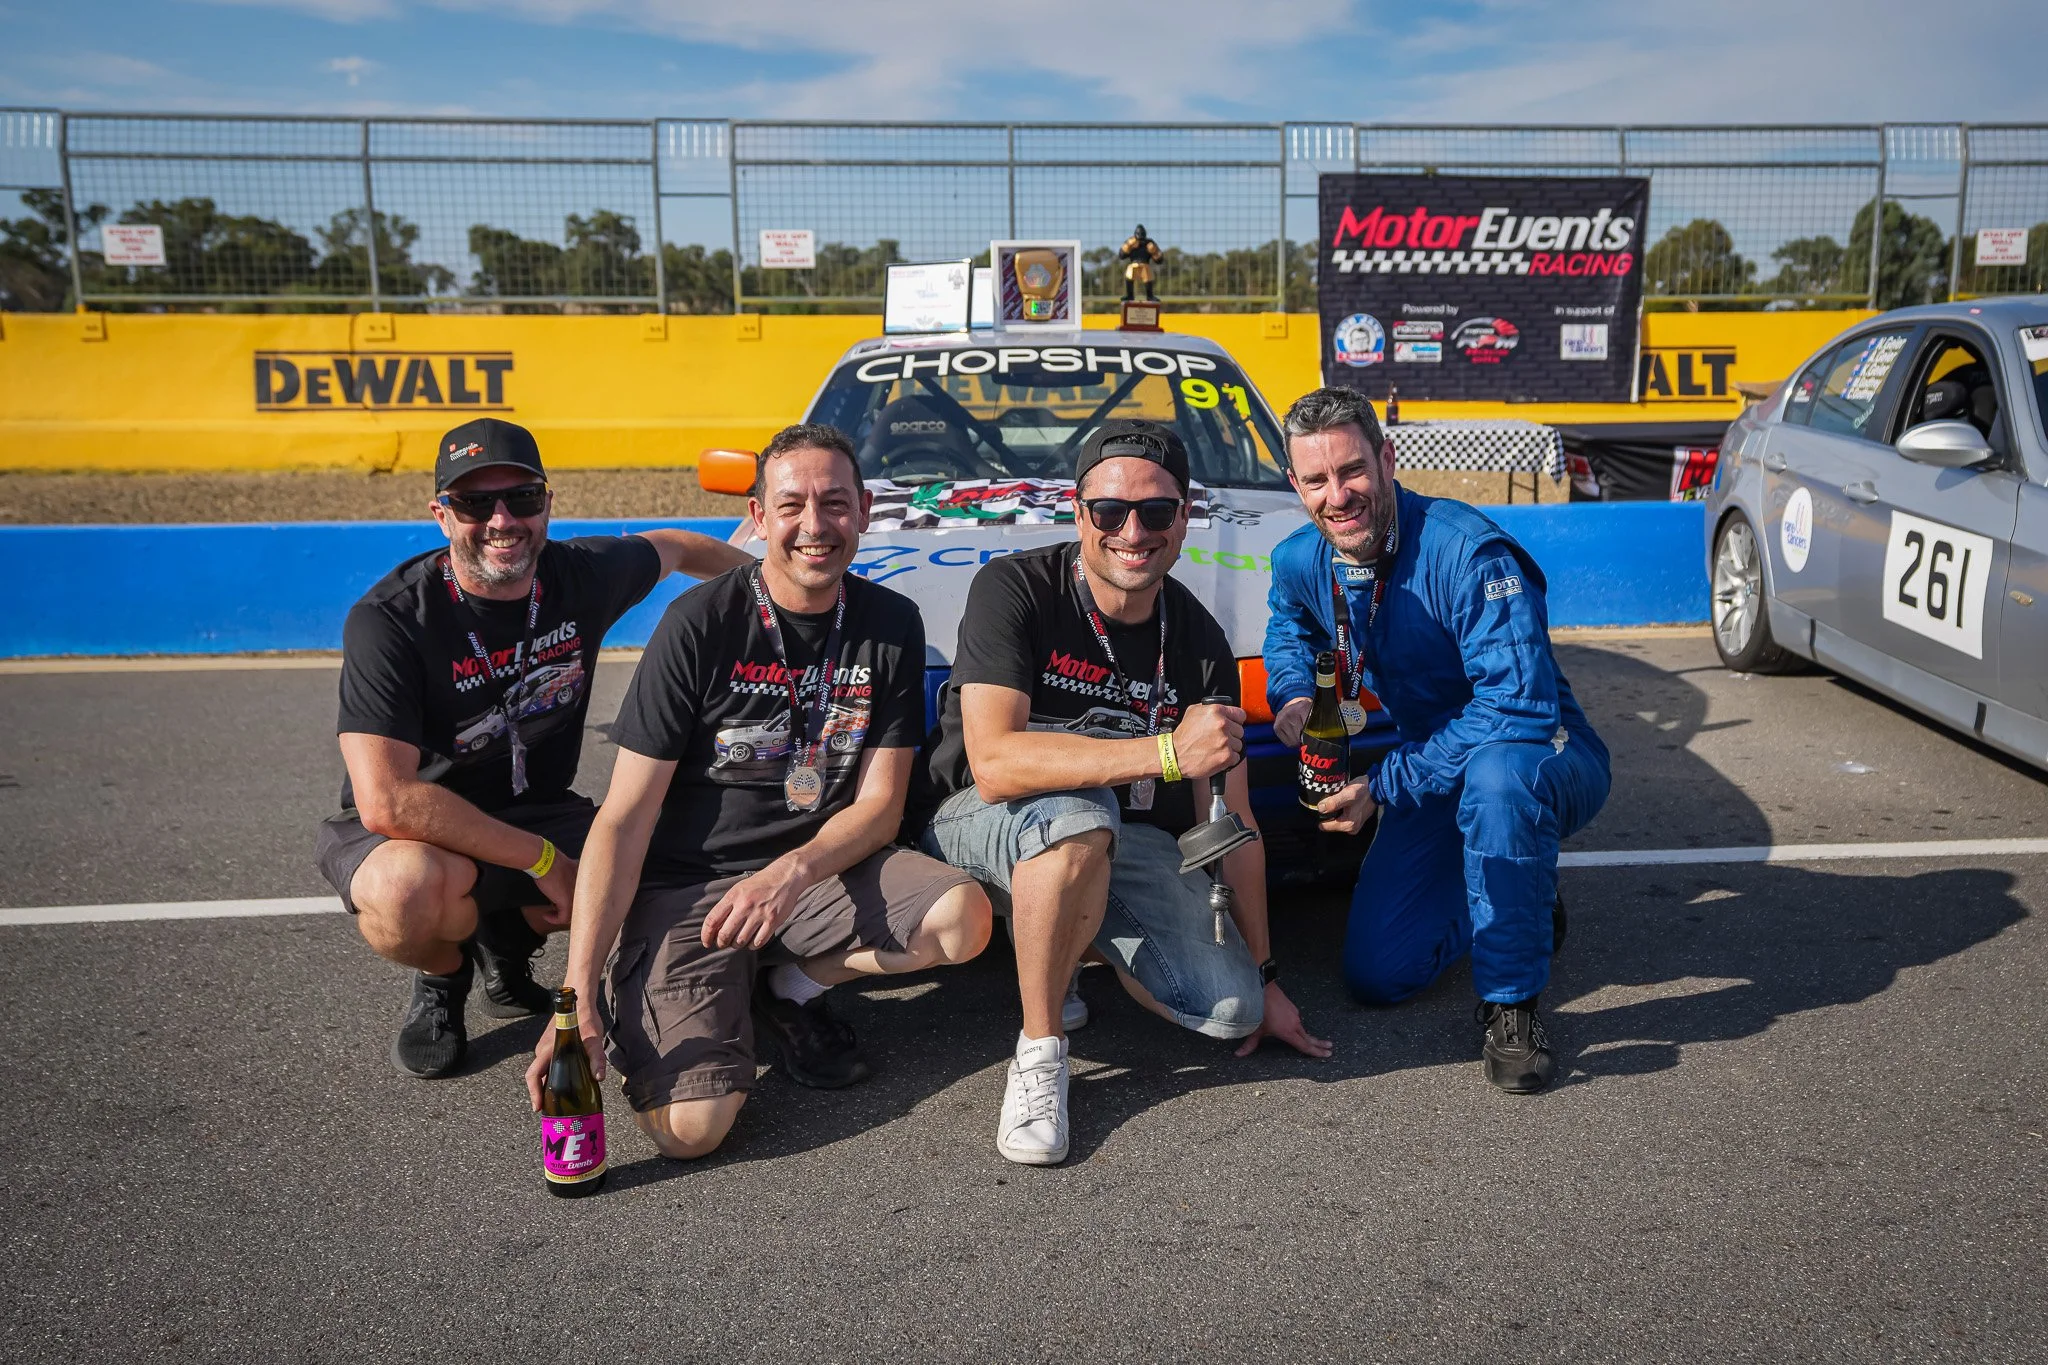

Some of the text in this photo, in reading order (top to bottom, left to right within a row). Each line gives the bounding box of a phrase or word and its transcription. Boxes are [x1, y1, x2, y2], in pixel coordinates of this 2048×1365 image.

[1333, 206, 1635, 250] MotorEvents
[1529, 252, 1634, 277] RACING
[1401, 303, 1459, 316] Powered by
[1565, 306, 1602, 317] support
[1603, 304, 1616, 316] of
[856, 347, 1217, 383] CHOPSHOP
[1180, 377, 1251, 417] 91
[889, 420, 946, 434] sparco
[1487, 577, 1519, 594] rpm
[1899, 529, 1972, 629] 261
[537, 636, 581, 662] RACING
[830, 685, 873, 698] ACING
[1001, 1045, 1023, 1057] LACOSTE
[545, 1132, 586, 1162] ME
